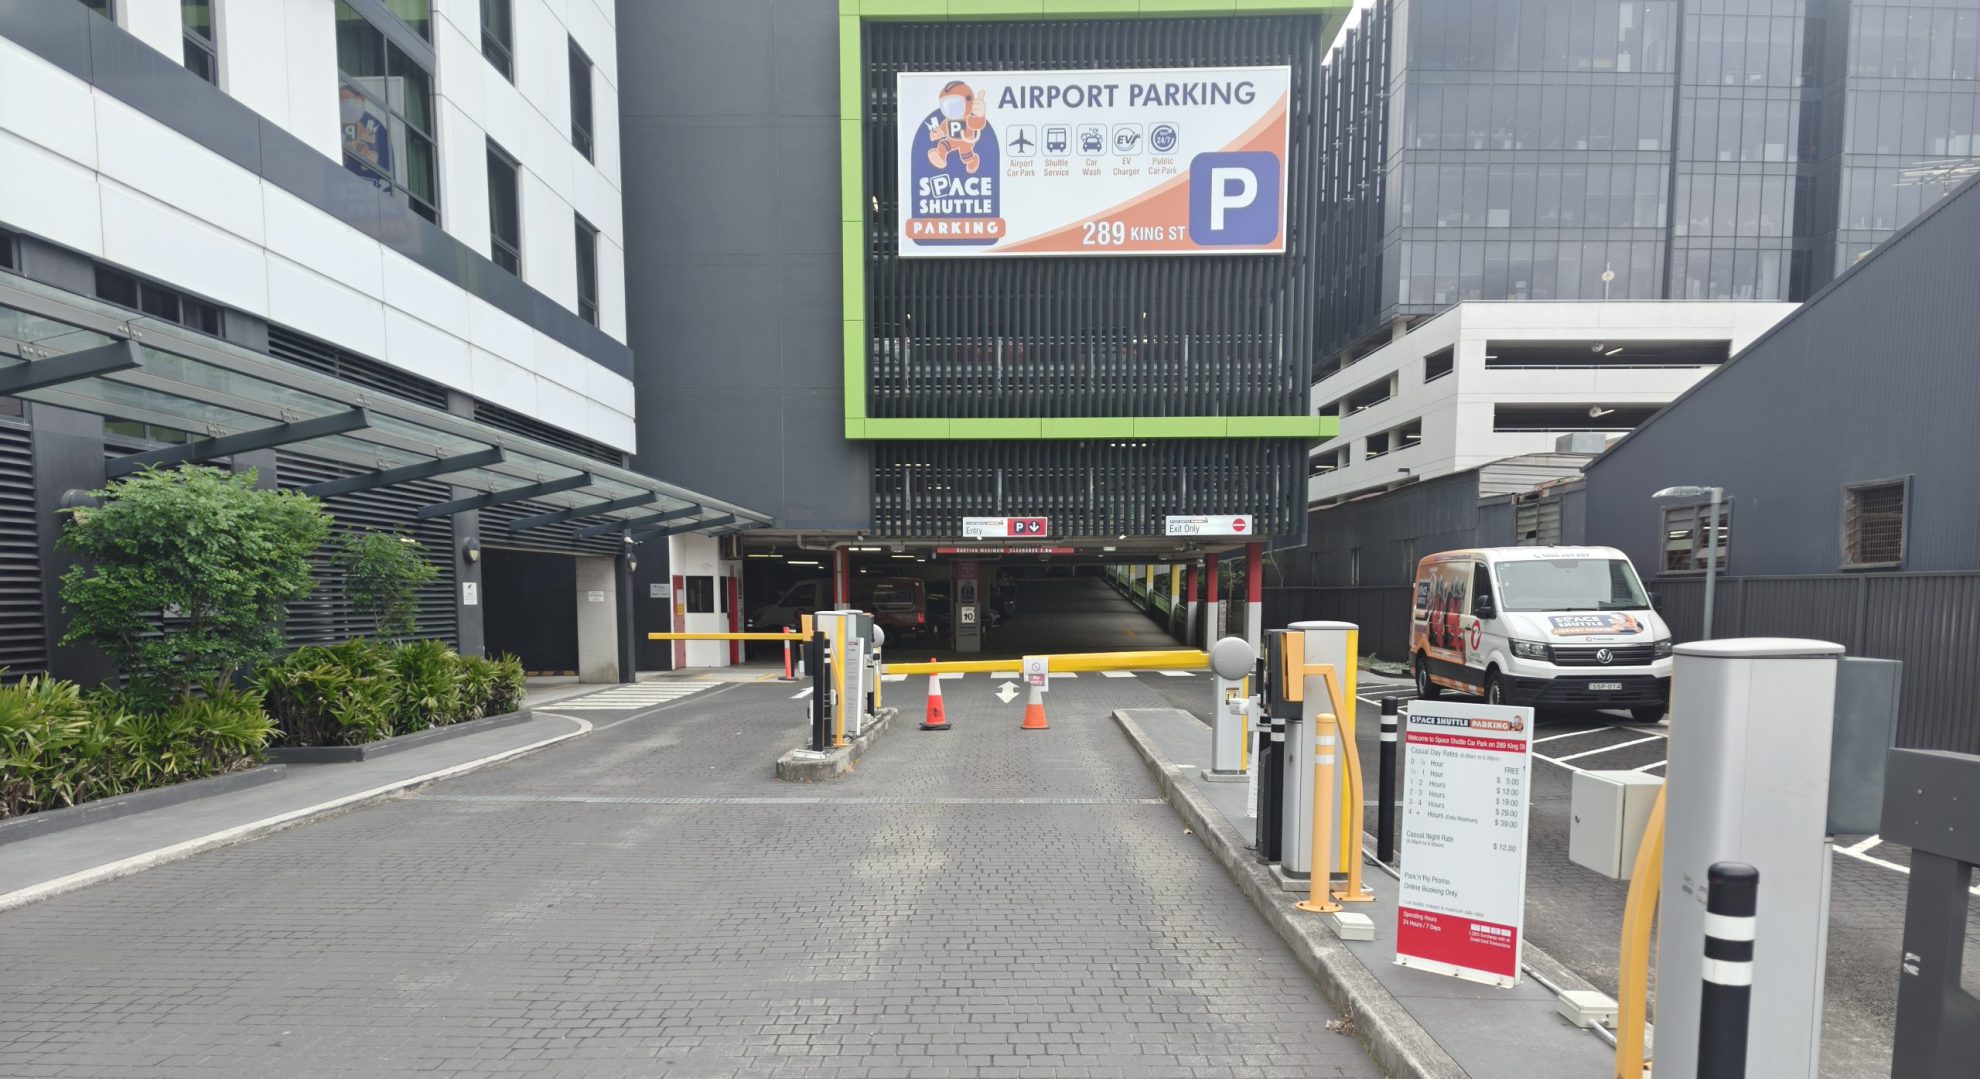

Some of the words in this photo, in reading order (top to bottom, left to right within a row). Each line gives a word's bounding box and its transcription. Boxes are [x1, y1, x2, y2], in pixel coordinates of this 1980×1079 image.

[998, 84, 1119, 109] AIRPORT
[1130, 81, 1256, 107] PARKING
[951, 122, 962, 137] P
[1156, 136, 1171, 144] 24/7
[1010, 160, 1033, 168] Airport
[1152, 157, 1174, 165] Public
[1020, 169, 1036, 177] Park
[1083, 168, 1102, 176] Wash
[1113, 168, 1140, 176] Charger
[1148, 167, 1161, 175] Car
[920, 176, 992, 197] SPACE
[1210, 167, 1258, 231] P
[920, 199, 992, 214] SHUTTLE
[914, 222, 998, 235] PARKING
[1082, 221, 1125, 245] 289
[1131, 227, 1164, 241] KING
[1168, 226, 1185, 241] ST
[966, 527, 982, 535] Entry
[1016, 523, 1024, 532] P
[1170, 525, 1182, 533] Exit
[1184, 524, 1200, 534] Only
[963, 612, 973, 621] 10
[1412, 716, 1435, 724] SPACE
[1436, 718, 1469, 727] SHUTTLE
[1472, 720, 1509, 730] PARKING
[1408, 734, 1429, 742] Welcome
[1507, 742, 1519, 750] King
[1411, 747, 1430, 755] Casual
[1431, 748, 1441, 757] Day
[1443, 750, 1458, 758] Rates
[1430, 760, 1444, 768] Hour
[1504, 767, 1520, 775] FREE
[1430, 770, 1444, 778] Hour
[1506, 778, 1520, 786] 5.00
[1430, 780, 1446, 788] Hours
[1496, 787, 1500, 795] $
[1502, 788, 1519, 797] 12.00
[1429, 790, 1445, 799] Hours
[1502, 798, 1519, 807] 19.00
[1428, 801, 1445, 809] Hours
[1495, 808, 1500, 816] $
[1501, 809, 1518, 818] 29.00
[1427, 810, 1444, 819] Hours
[1500, 820, 1518, 829] 39.00
[1407, 830, 1425, 839] Casual
[1426, 832, 1440, 842] Night
[1442, 834, 1454, 843] Rate
[1493, 842, 1497, 850] $
[1500, 844, 1517, 853] 12.00
[1432, 877, 1450, 885] Promo
[1404, 883, 1421, 891] Online
[1422, 885, 1444, 896] Booking
[1445, 888, 1458, 898] Only
[1403, 911, 1423, 921] Operating
[1410, 920, 1422, 928] Hours
[1430, 924, 1442, 932] Days
